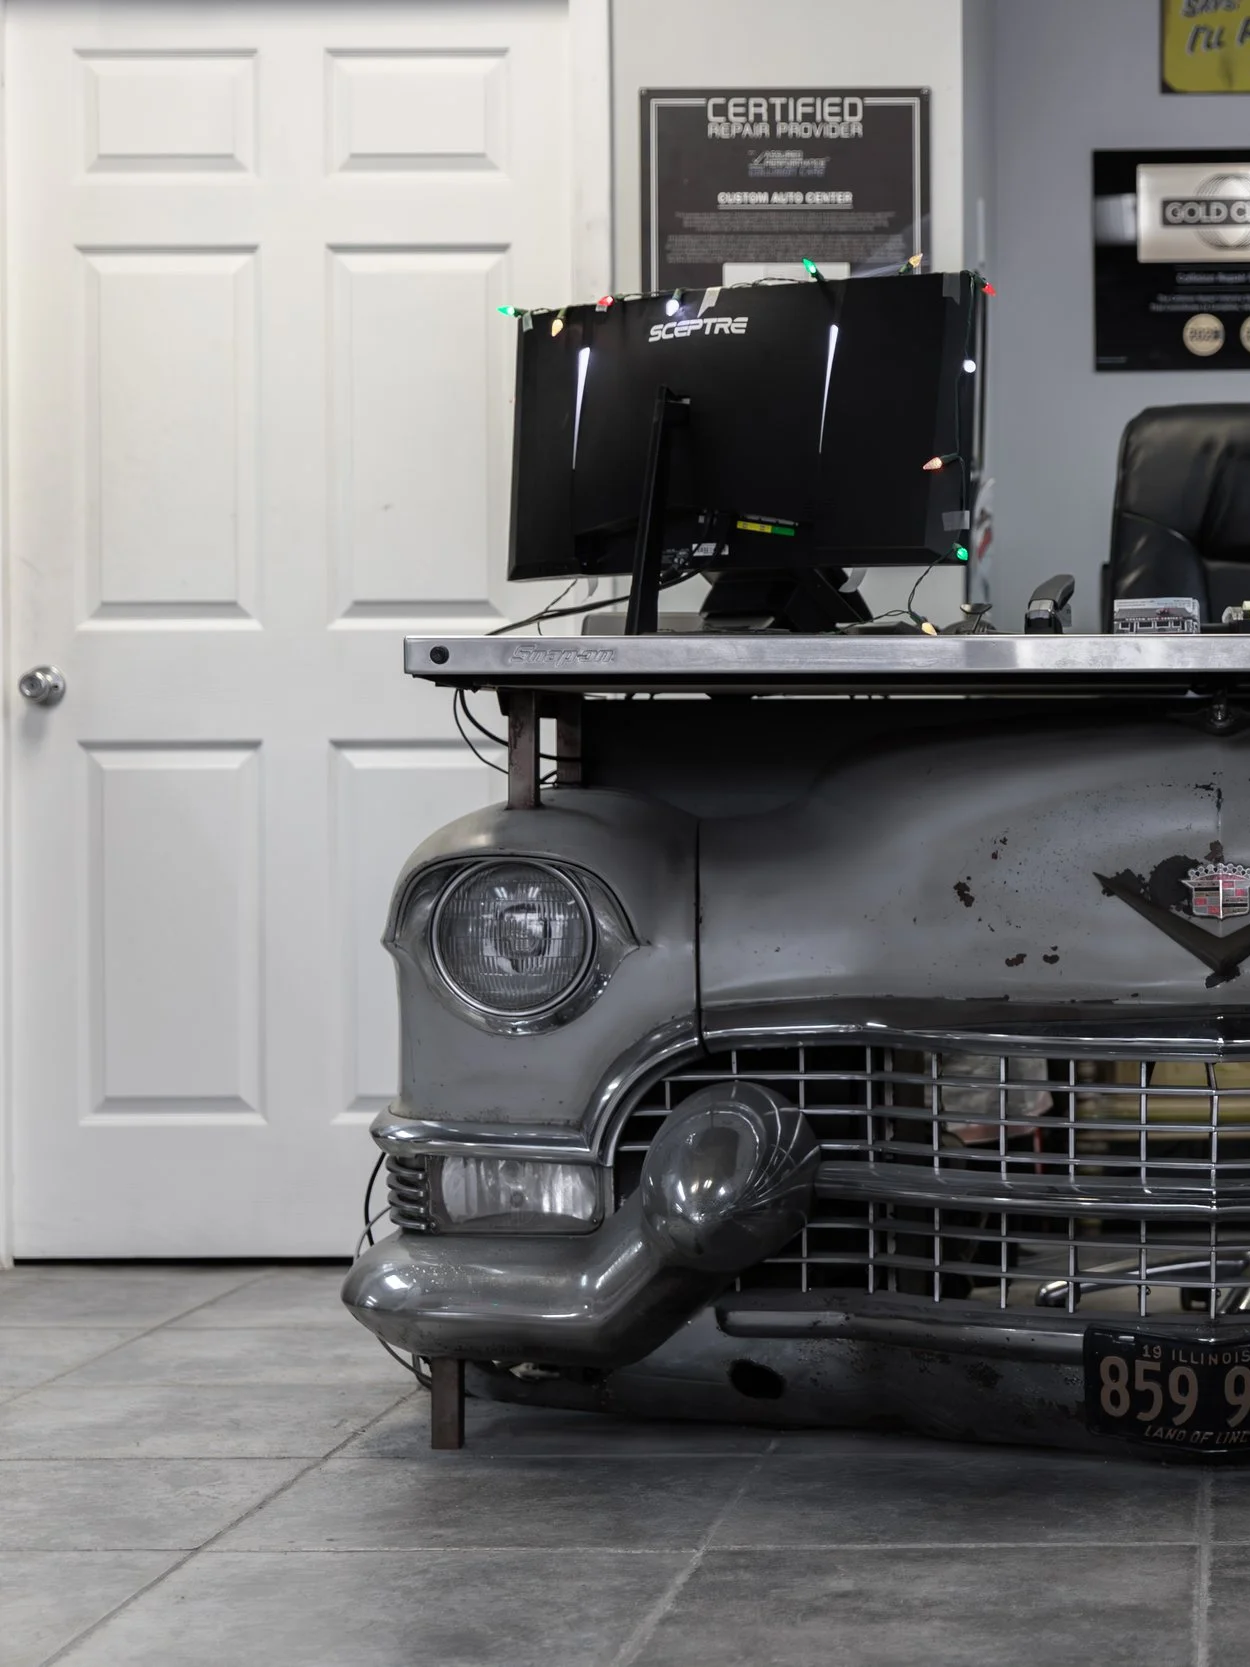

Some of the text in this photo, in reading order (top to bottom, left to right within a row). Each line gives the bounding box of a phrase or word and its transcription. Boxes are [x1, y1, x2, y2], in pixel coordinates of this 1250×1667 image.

[707, 97, 863, 122] CERTIFIED
[707, 122, 863, 139] REPAIR PROVIDER
[717, 191, 853, 204] CUSTOM AUTO CENTER
[1165, 201, 1228, 224] GOLD
[648, 316, 749, 343] SCEPTRE
[509, 643, 614, 668] Snap-on
[1143, 1345, 1162, 1359] 19
[1171, 1349, 1250, 1366] ILLINOIS
[1100, 1355, 1199, 1426] 859
[1144, 1425, 1186, 1442] LAND
[1190, 1431, 1214, 1444] OF
